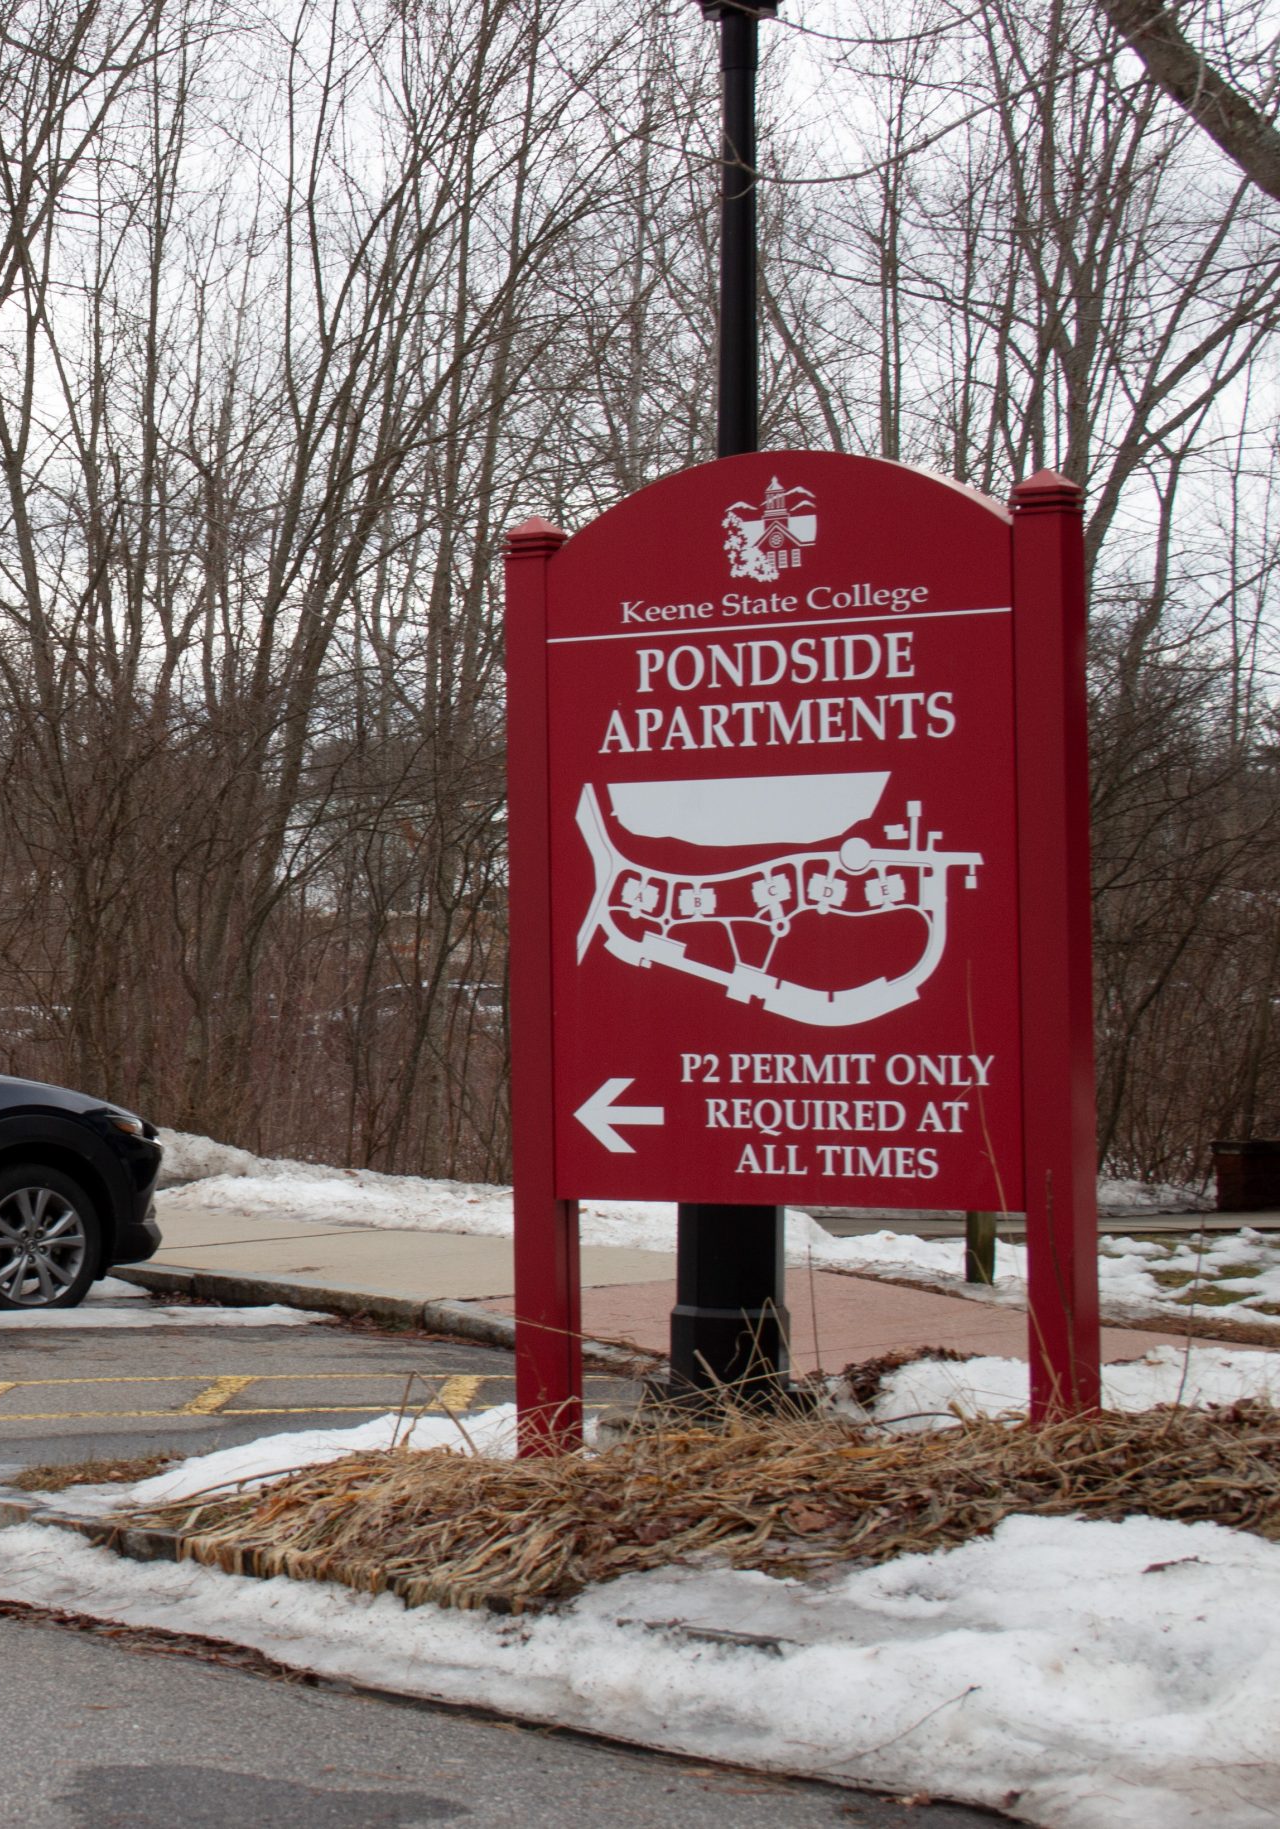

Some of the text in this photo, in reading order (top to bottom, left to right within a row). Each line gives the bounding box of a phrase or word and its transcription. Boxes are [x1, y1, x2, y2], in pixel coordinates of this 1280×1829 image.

[622, 584, 929, 624] Keene State College
[636, 632, 916, 693] PONDSIDE
[599, 692, 957, 754] APARTMENTS
[634, 892, 643, 902] A
[694, 897, 701, 908] B
[768, 885, 777, 896] C
[823, 887, 833, 898] D
[880, 885, 889, 896] E
[681, 1054, 995, 1086] P2 PERMIT ONLY
[706, 1099, 969, 1136] REQUIRED AT
[736, 1144, 939, 1179] ALL TIMES
